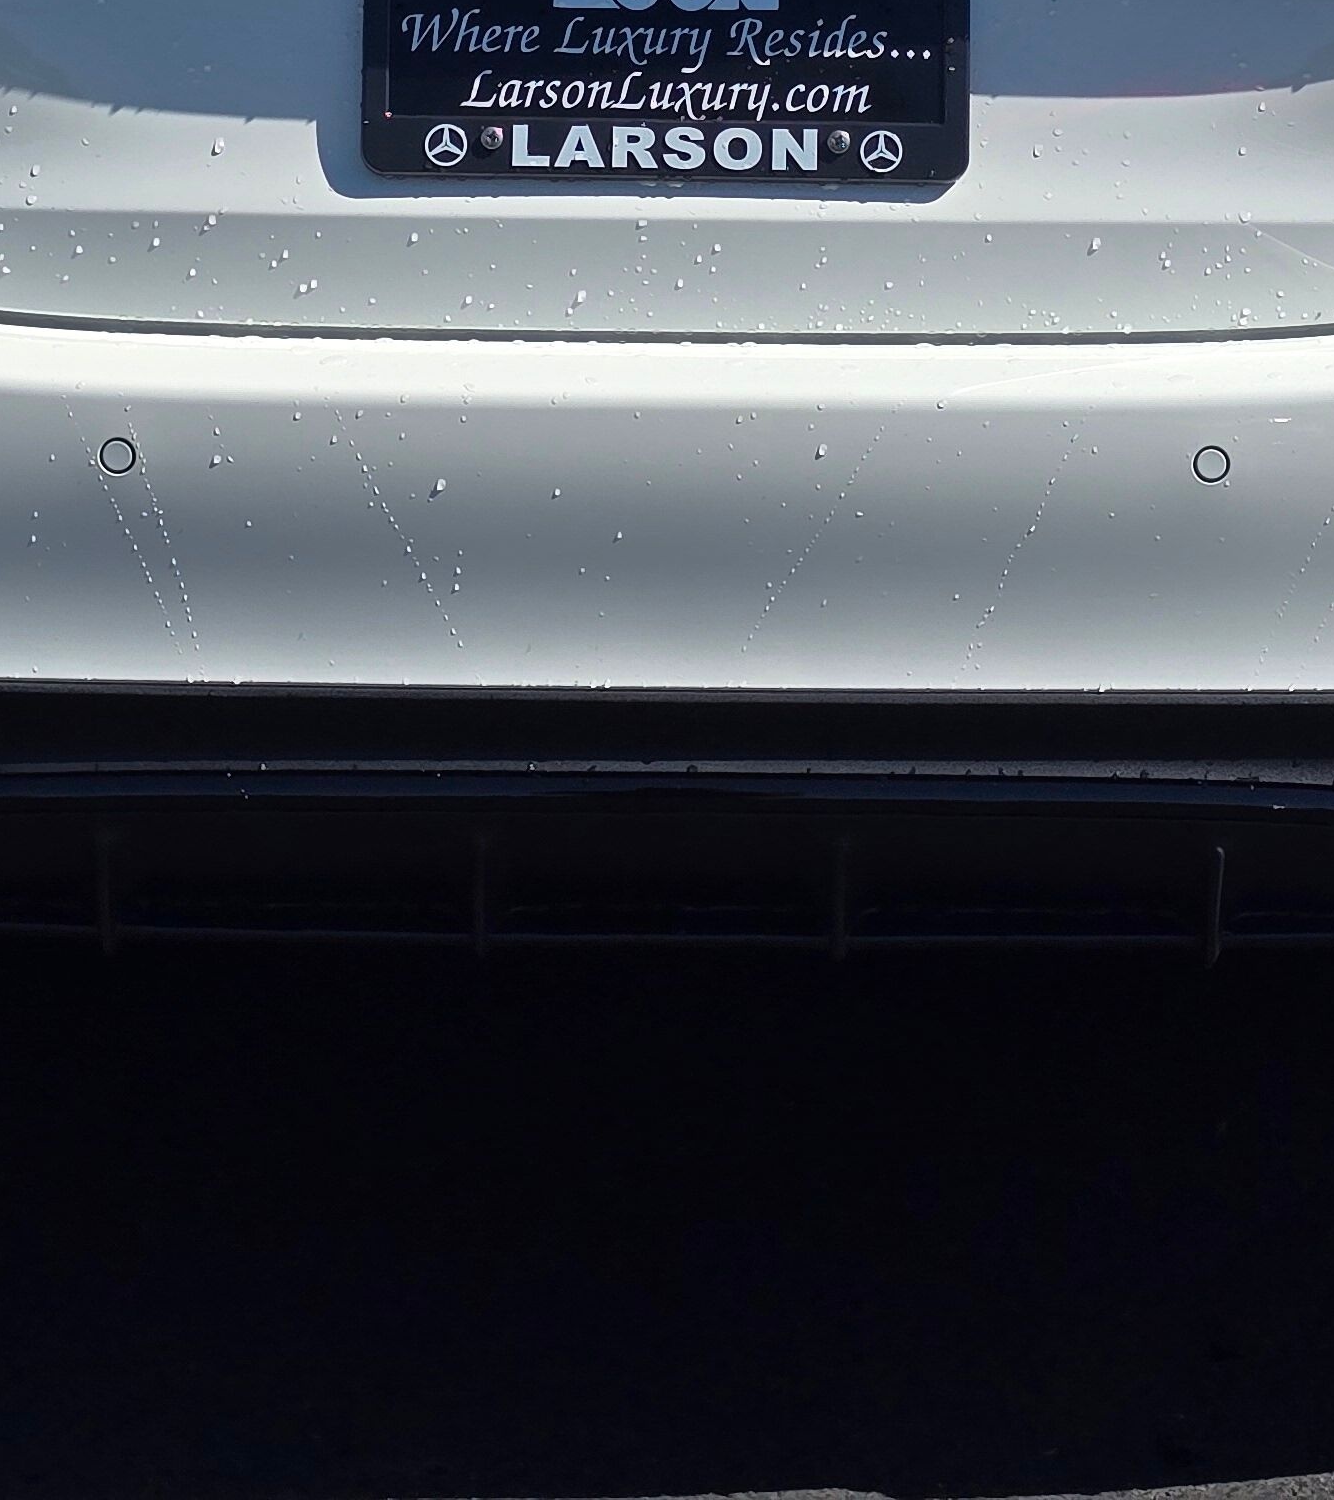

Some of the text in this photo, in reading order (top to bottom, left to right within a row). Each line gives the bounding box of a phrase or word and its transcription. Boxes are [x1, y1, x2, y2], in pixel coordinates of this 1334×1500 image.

[401, 7, 932, 75] Where Luxury Resides...
[459, 69, 873, 122] LarsonLuxury.com
[511, 123, 819, 172] LARSON
